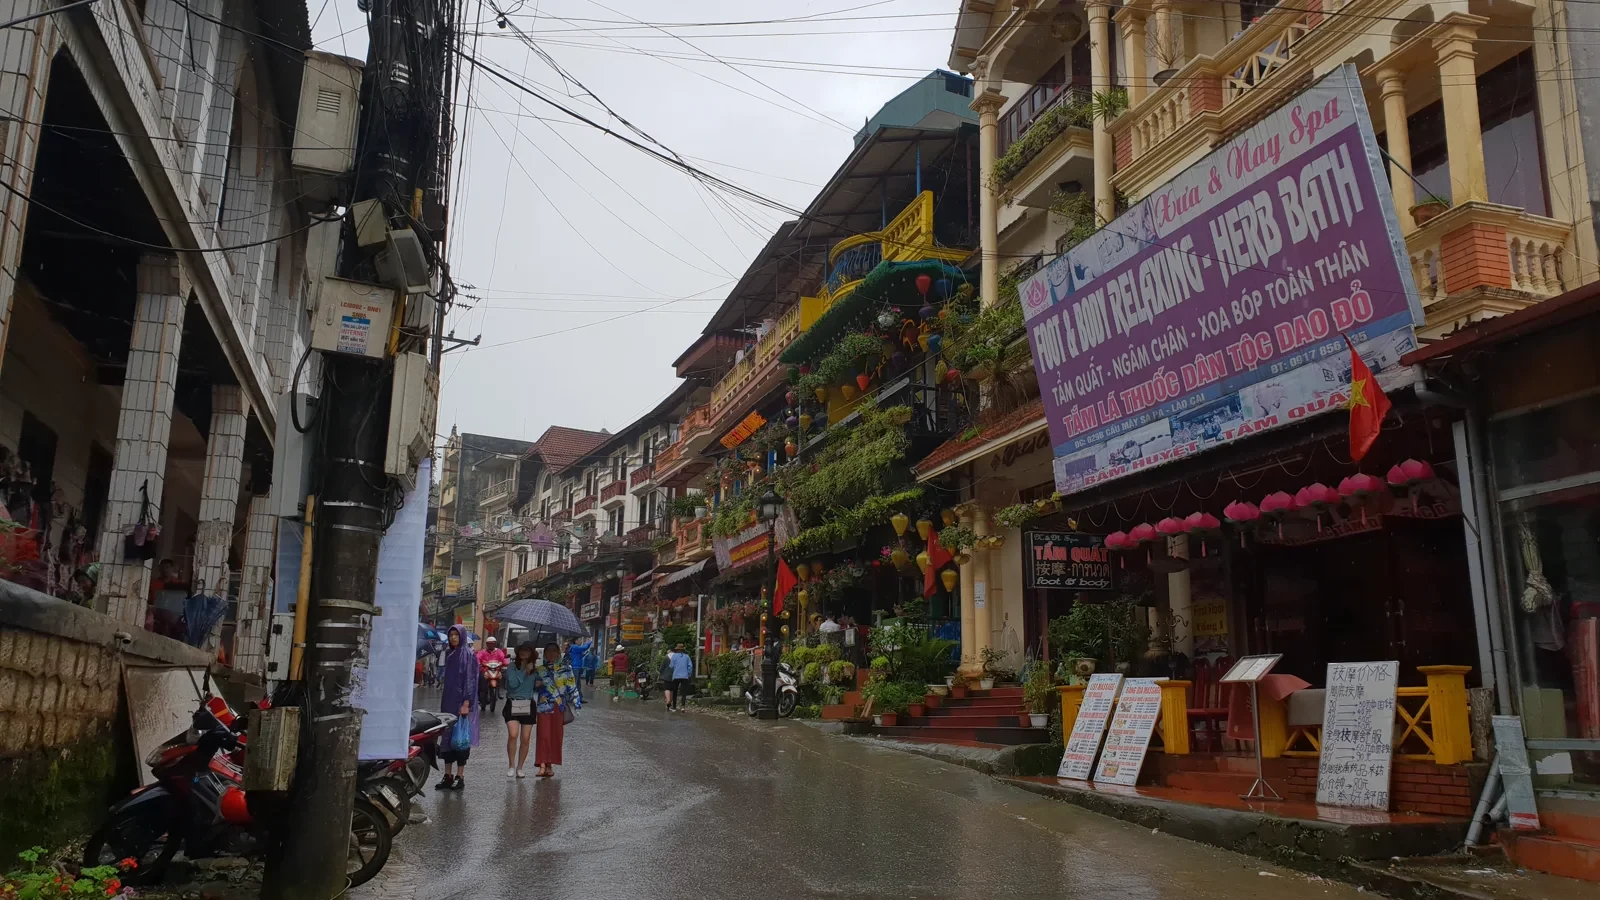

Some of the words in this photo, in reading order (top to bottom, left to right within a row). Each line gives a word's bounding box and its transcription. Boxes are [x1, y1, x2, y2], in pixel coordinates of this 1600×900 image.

[1208, 166, 1223, 195] &
[1227, 133, 1284, 180] Nay
[1289, 96, 1343, 144] Spa
[1033, 314, 1067, 374] FOOT
[1063, 310, 1079, 359] &
[1073, 287, 1112, 352] BODY
[1106, 234, 1205, 338] RELAXING
[1209, 190, 1283, 288] HERB
[1278, 143, 1364, 244] BATH
[1075, 356, 1104, 397] QUẤT
[1112, 344, 1150, 380] NGÂM
[1150, 325, 1189, 362] CHÂN
[1198, 306, 1231, 342] XOA
[1231, 288, 1263, 326] BÓP
[1264, 266, 1315, 309] TOÀN
[1315, 240, 1370, 287] THÂN
[341, 329, 367, 337] INTERNET
[1062, 404, 1098, 438] TẮM
[1098, 391, 1122, 425] LÁ
[1120, 366, 1181, 413] THUỐC
[1181, 350, 1227, 392] DÂN
[1227, 331, 1274, 372] TỘC
[1275, 308, 1329, 353] DAO
[1330, 279, 1374, 331] ĐỎ
[1289, 349, 1315, 366] 0917
[1319, 341, 1341, 355] 856
[1140, 414, 1151, 424] SA
[1151, 410, 1165, 421] PA
[1189, 393, 1206, 405] CAI
[1036, 560, 1066, 577] 按摩
[1036, 576, 1062, 585] foot
[1078, 577, 1111, 588] body
[1333, 664, 1392, 683] 按摩价格
[1325, 728, 1384, 744] 全身按摩舒服
